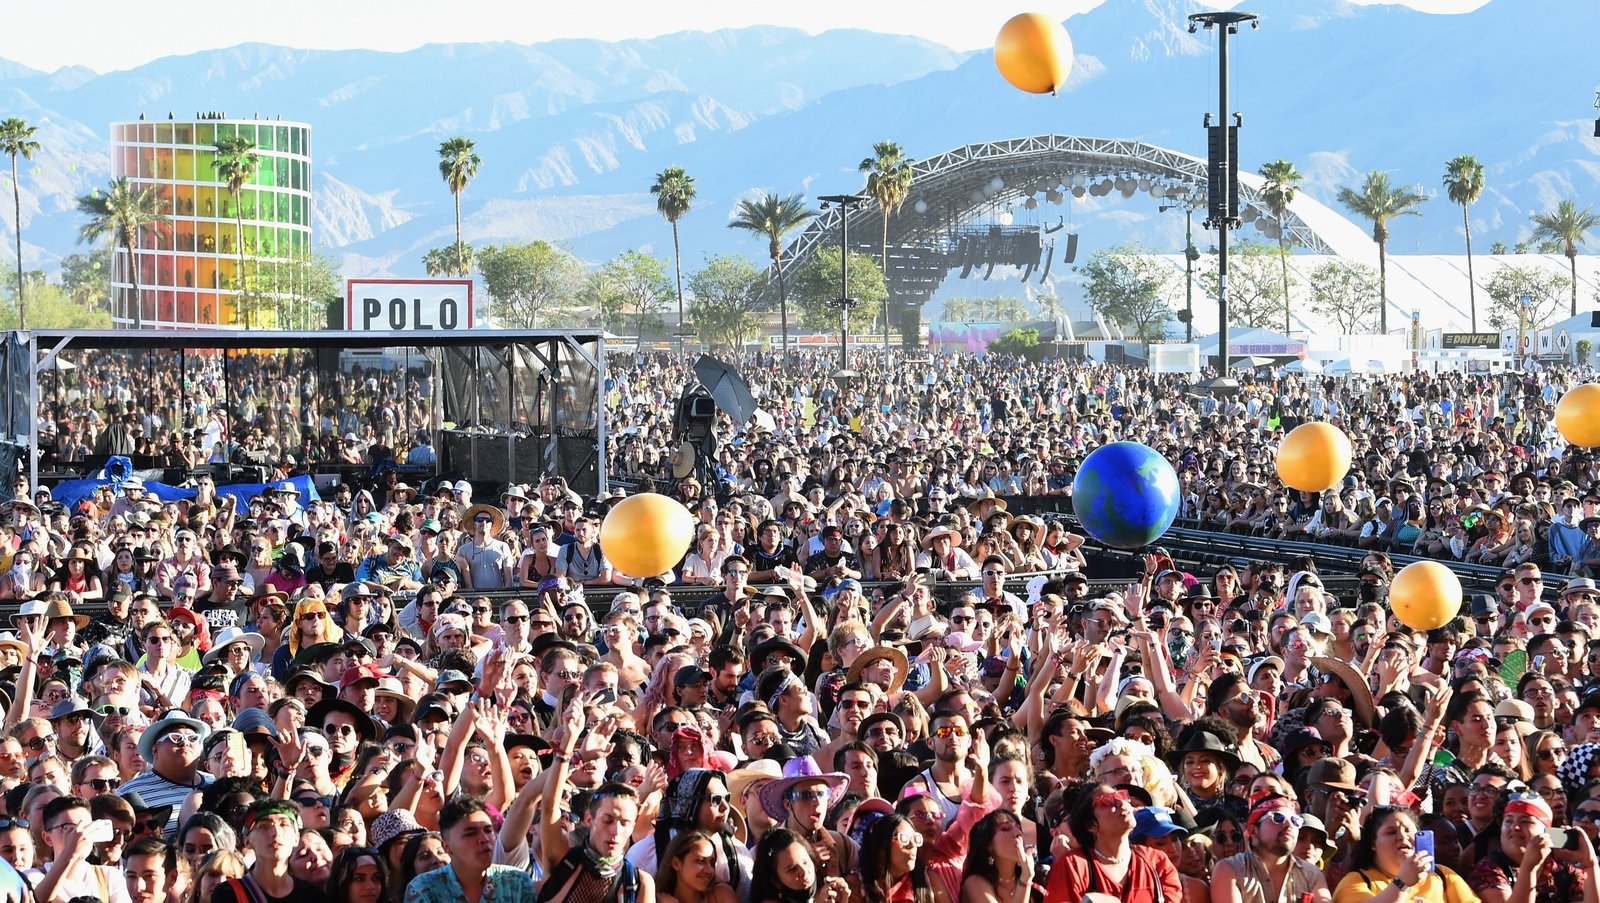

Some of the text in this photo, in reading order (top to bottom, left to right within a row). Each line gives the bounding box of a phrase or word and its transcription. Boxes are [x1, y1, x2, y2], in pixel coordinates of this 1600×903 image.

[363, 298, 458, 330] POLO
[1453, 334, 1498, 344] DRIVE-IN
[1239, 344, 1249, 354] THE
